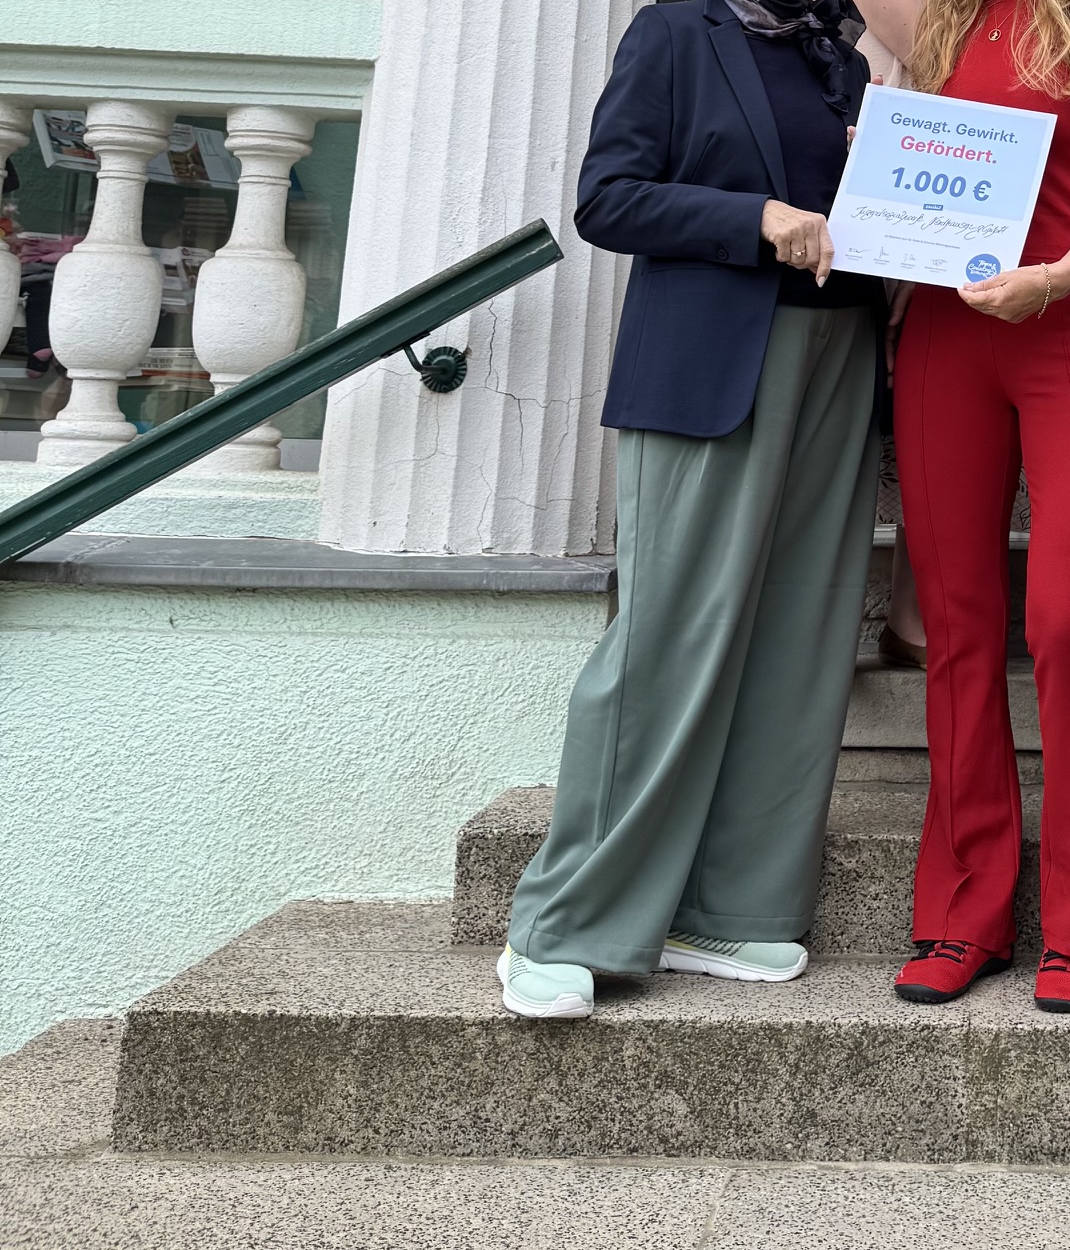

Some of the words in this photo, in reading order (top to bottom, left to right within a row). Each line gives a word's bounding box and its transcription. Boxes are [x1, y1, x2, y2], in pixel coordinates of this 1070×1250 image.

[890, 112, 951, 134] Gewagt.
[956, 123, 1018, 144] Gewirkt.
[900, 135, 997, 164] Gefördert.
[892, 167, 967, 198] 1.000
[973, 180, 992, 201] €
